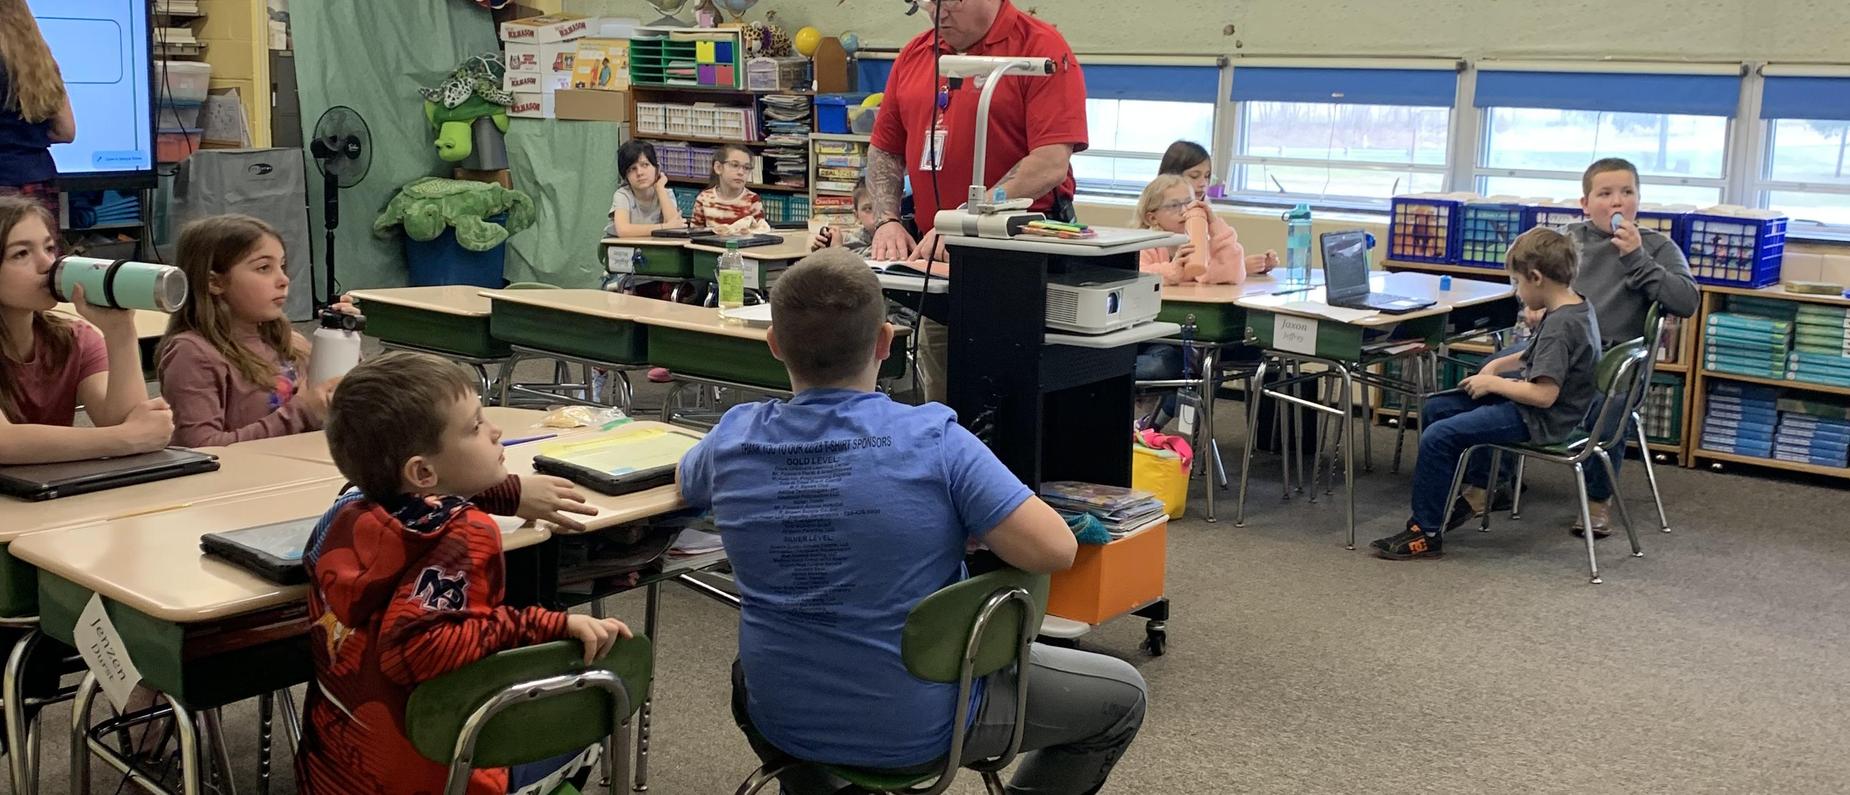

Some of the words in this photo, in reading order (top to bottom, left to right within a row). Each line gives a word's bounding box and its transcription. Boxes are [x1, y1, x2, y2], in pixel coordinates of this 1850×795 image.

[1281, 319, 1307, 332] Jaxon
[824, 440, 851, 453] T-SHIRT
[852, 435, 892, 450] SPONSORS
[786, 457, 810, 466] GOLD
[89, 617, 126, 681] Jenzen
[90, 643, 114, 681] Durst
